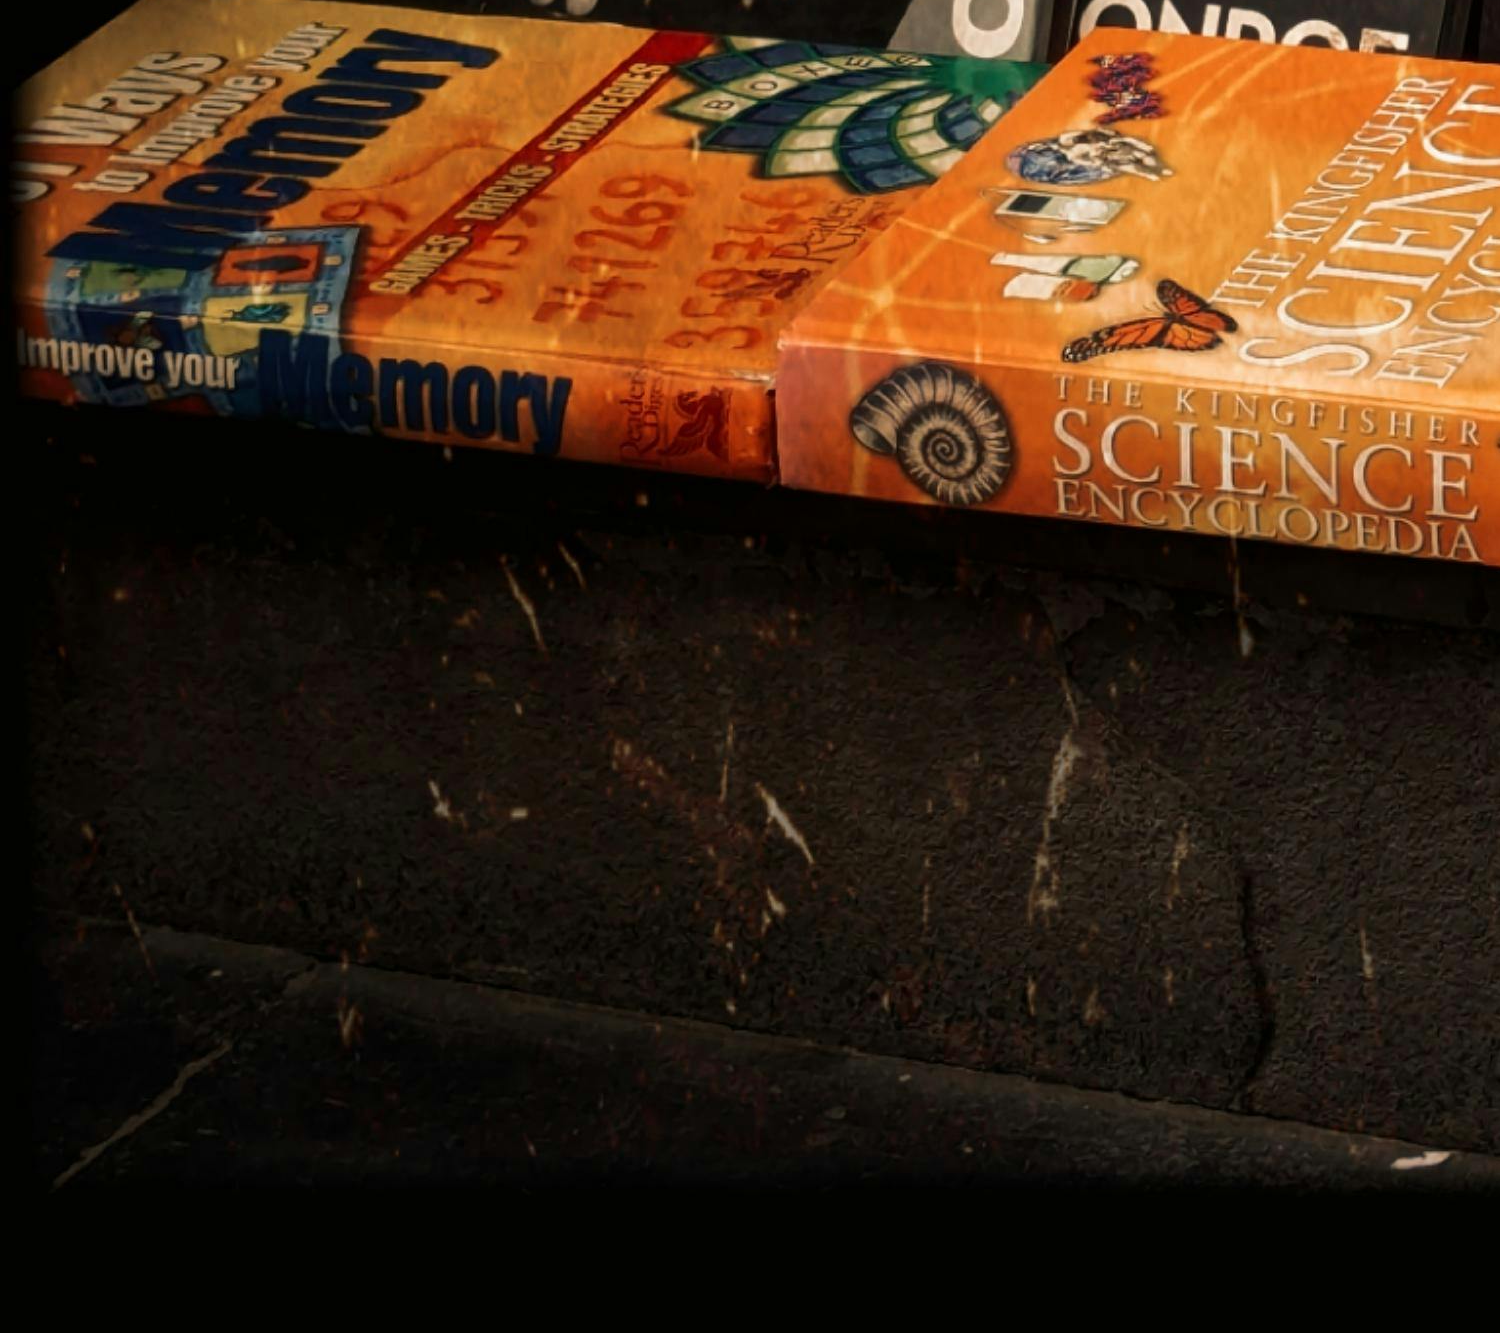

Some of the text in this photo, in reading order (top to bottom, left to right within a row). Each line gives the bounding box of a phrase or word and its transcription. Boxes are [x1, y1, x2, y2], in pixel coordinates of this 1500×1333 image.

[12, 49, 228, 148] Ways
[42, 28, 501, 271] Memory
[72, 169, 156, 195] to
[244, 21, 349, 73] your
[368, 233, 472, 296] GAMES
[453, 164, 554, 222] TRICKS
[536, 61, 672, 154] STRATEGIES
[1208, 73, 1456, 310] THE KINGFISHER
[163, 349, 242, 392] your
[256, 327, 574, 457] Memory
[1052, 373, 1482, 449] THE KINGFISHER
[1051, 406, 1481, 522] SCIENCE
[1053, 478, 1485, 564] ENCYCLOPEDIA
